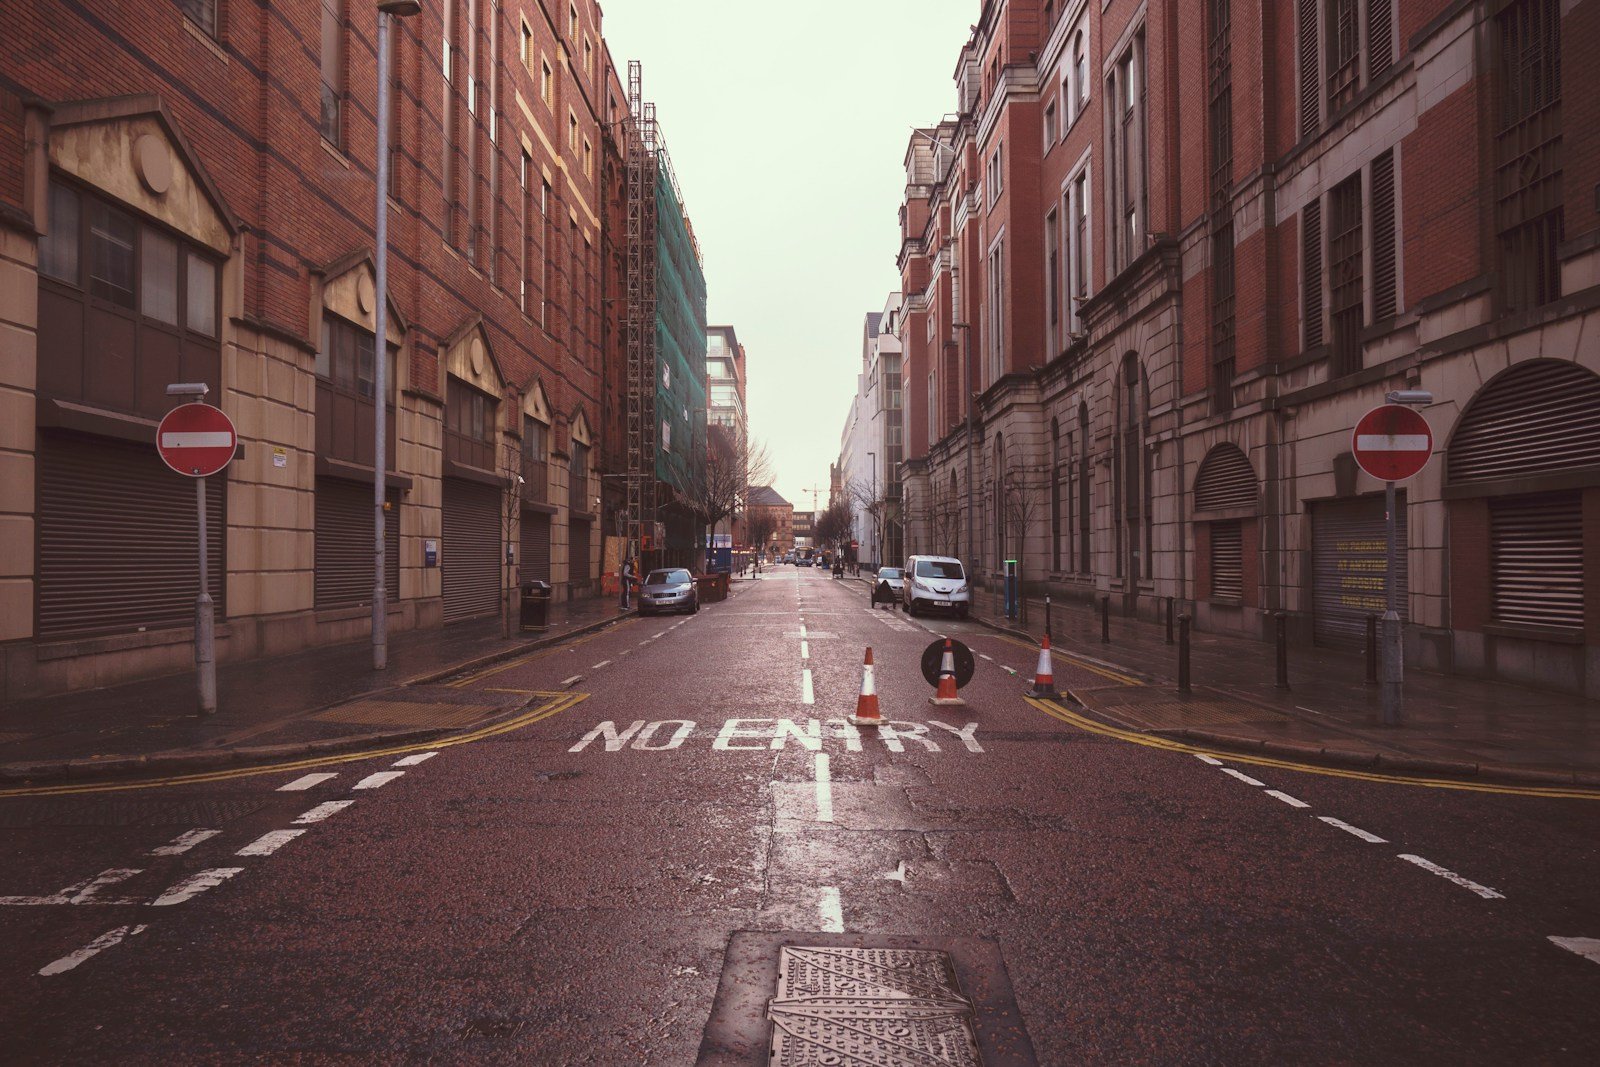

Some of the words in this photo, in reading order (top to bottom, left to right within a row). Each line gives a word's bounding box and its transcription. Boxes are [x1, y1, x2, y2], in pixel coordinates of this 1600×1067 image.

[1337, 559, 1347, 571] AT
[1341, 595, 1361, 608] THIS
[568, 719, 697, 752] NO
[712, 718, 985, 752] ENTRY
